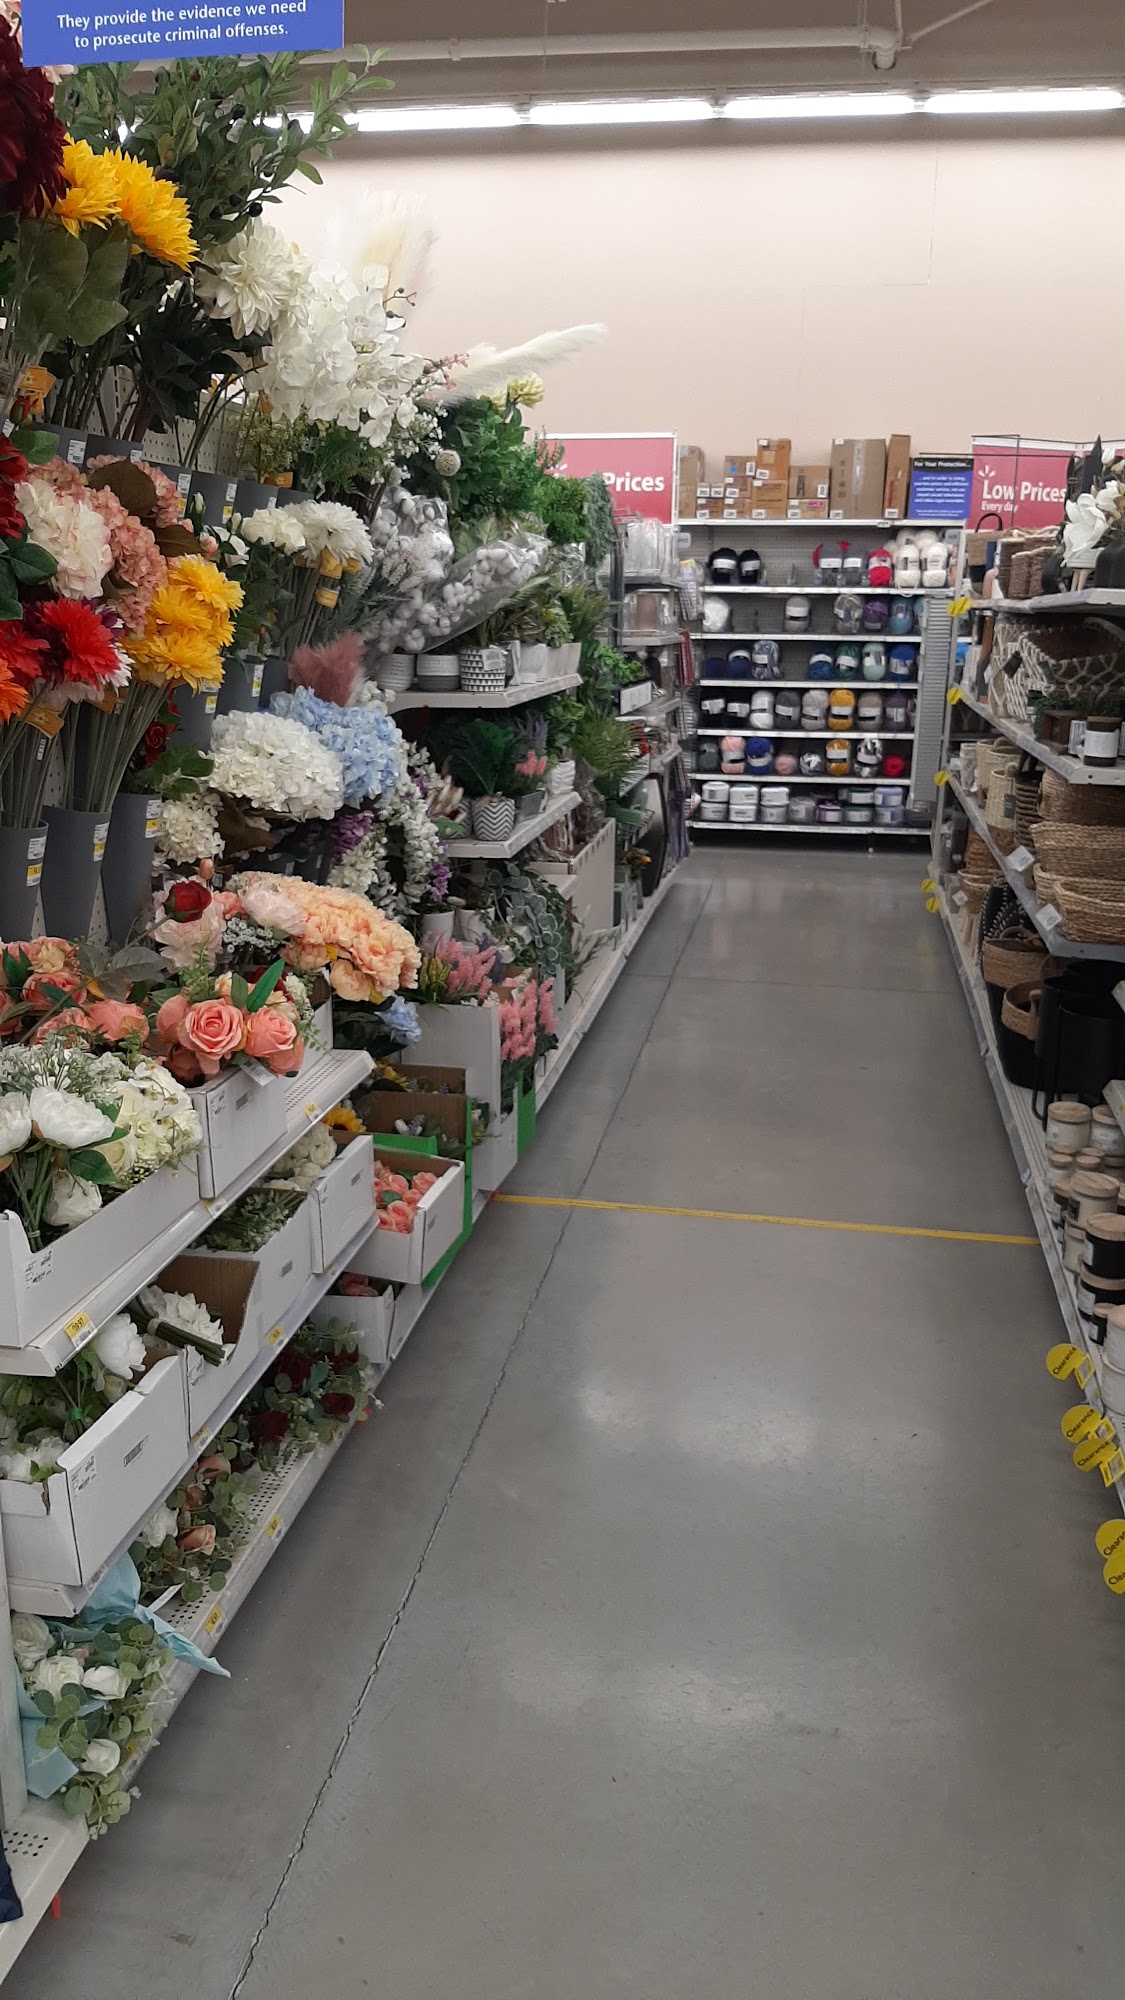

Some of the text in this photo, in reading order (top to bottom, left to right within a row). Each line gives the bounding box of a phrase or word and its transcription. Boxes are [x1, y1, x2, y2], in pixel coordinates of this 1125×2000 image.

[57, 0, 307, 31] They provide the evidence we need
[74, 22, 288, 51] to prosecute criminal offenses.
[602, 471, 665, 492] Prices
[982, 480, 1067, 503] Low Prices
[1052, 1346, 1077, 1375] Clearance
[1066, 1408, 1095, 1438] Clearance
[1077, 1440, 1110, 1466] Clearance
